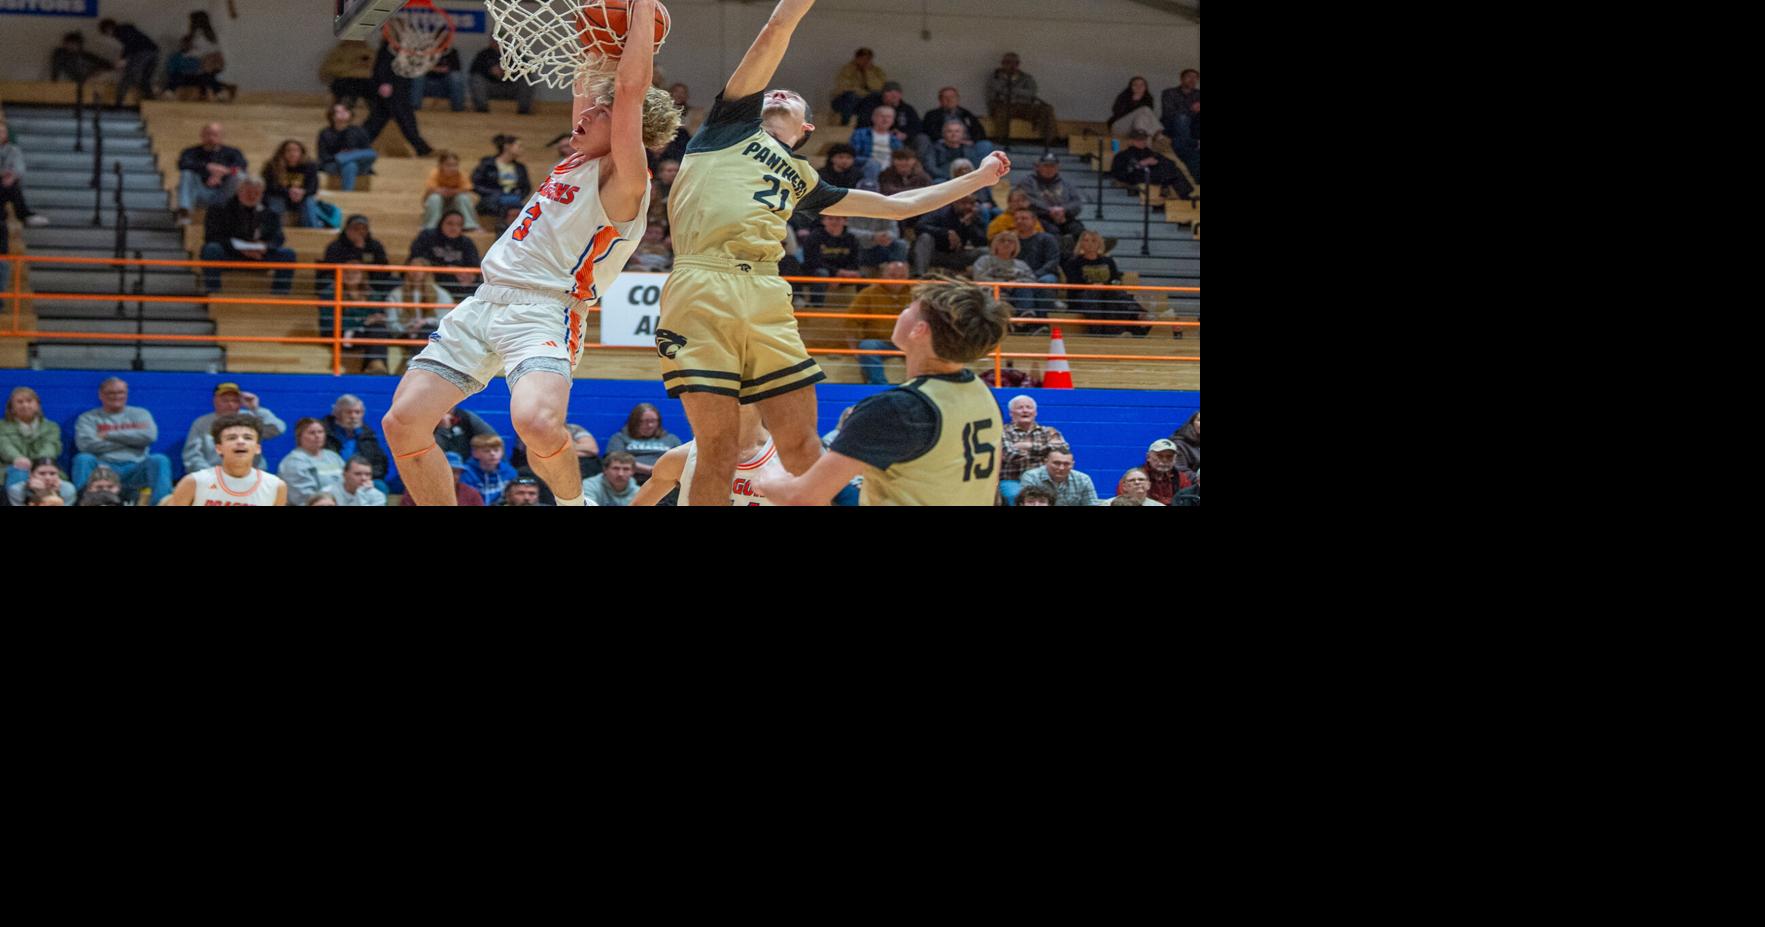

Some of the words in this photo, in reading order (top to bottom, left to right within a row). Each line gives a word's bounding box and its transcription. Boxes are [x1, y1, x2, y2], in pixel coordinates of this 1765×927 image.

[753, 174, 790, 211] 21
[512, 202, 542, 241] 3
[962, 418, 995, 482] 15
